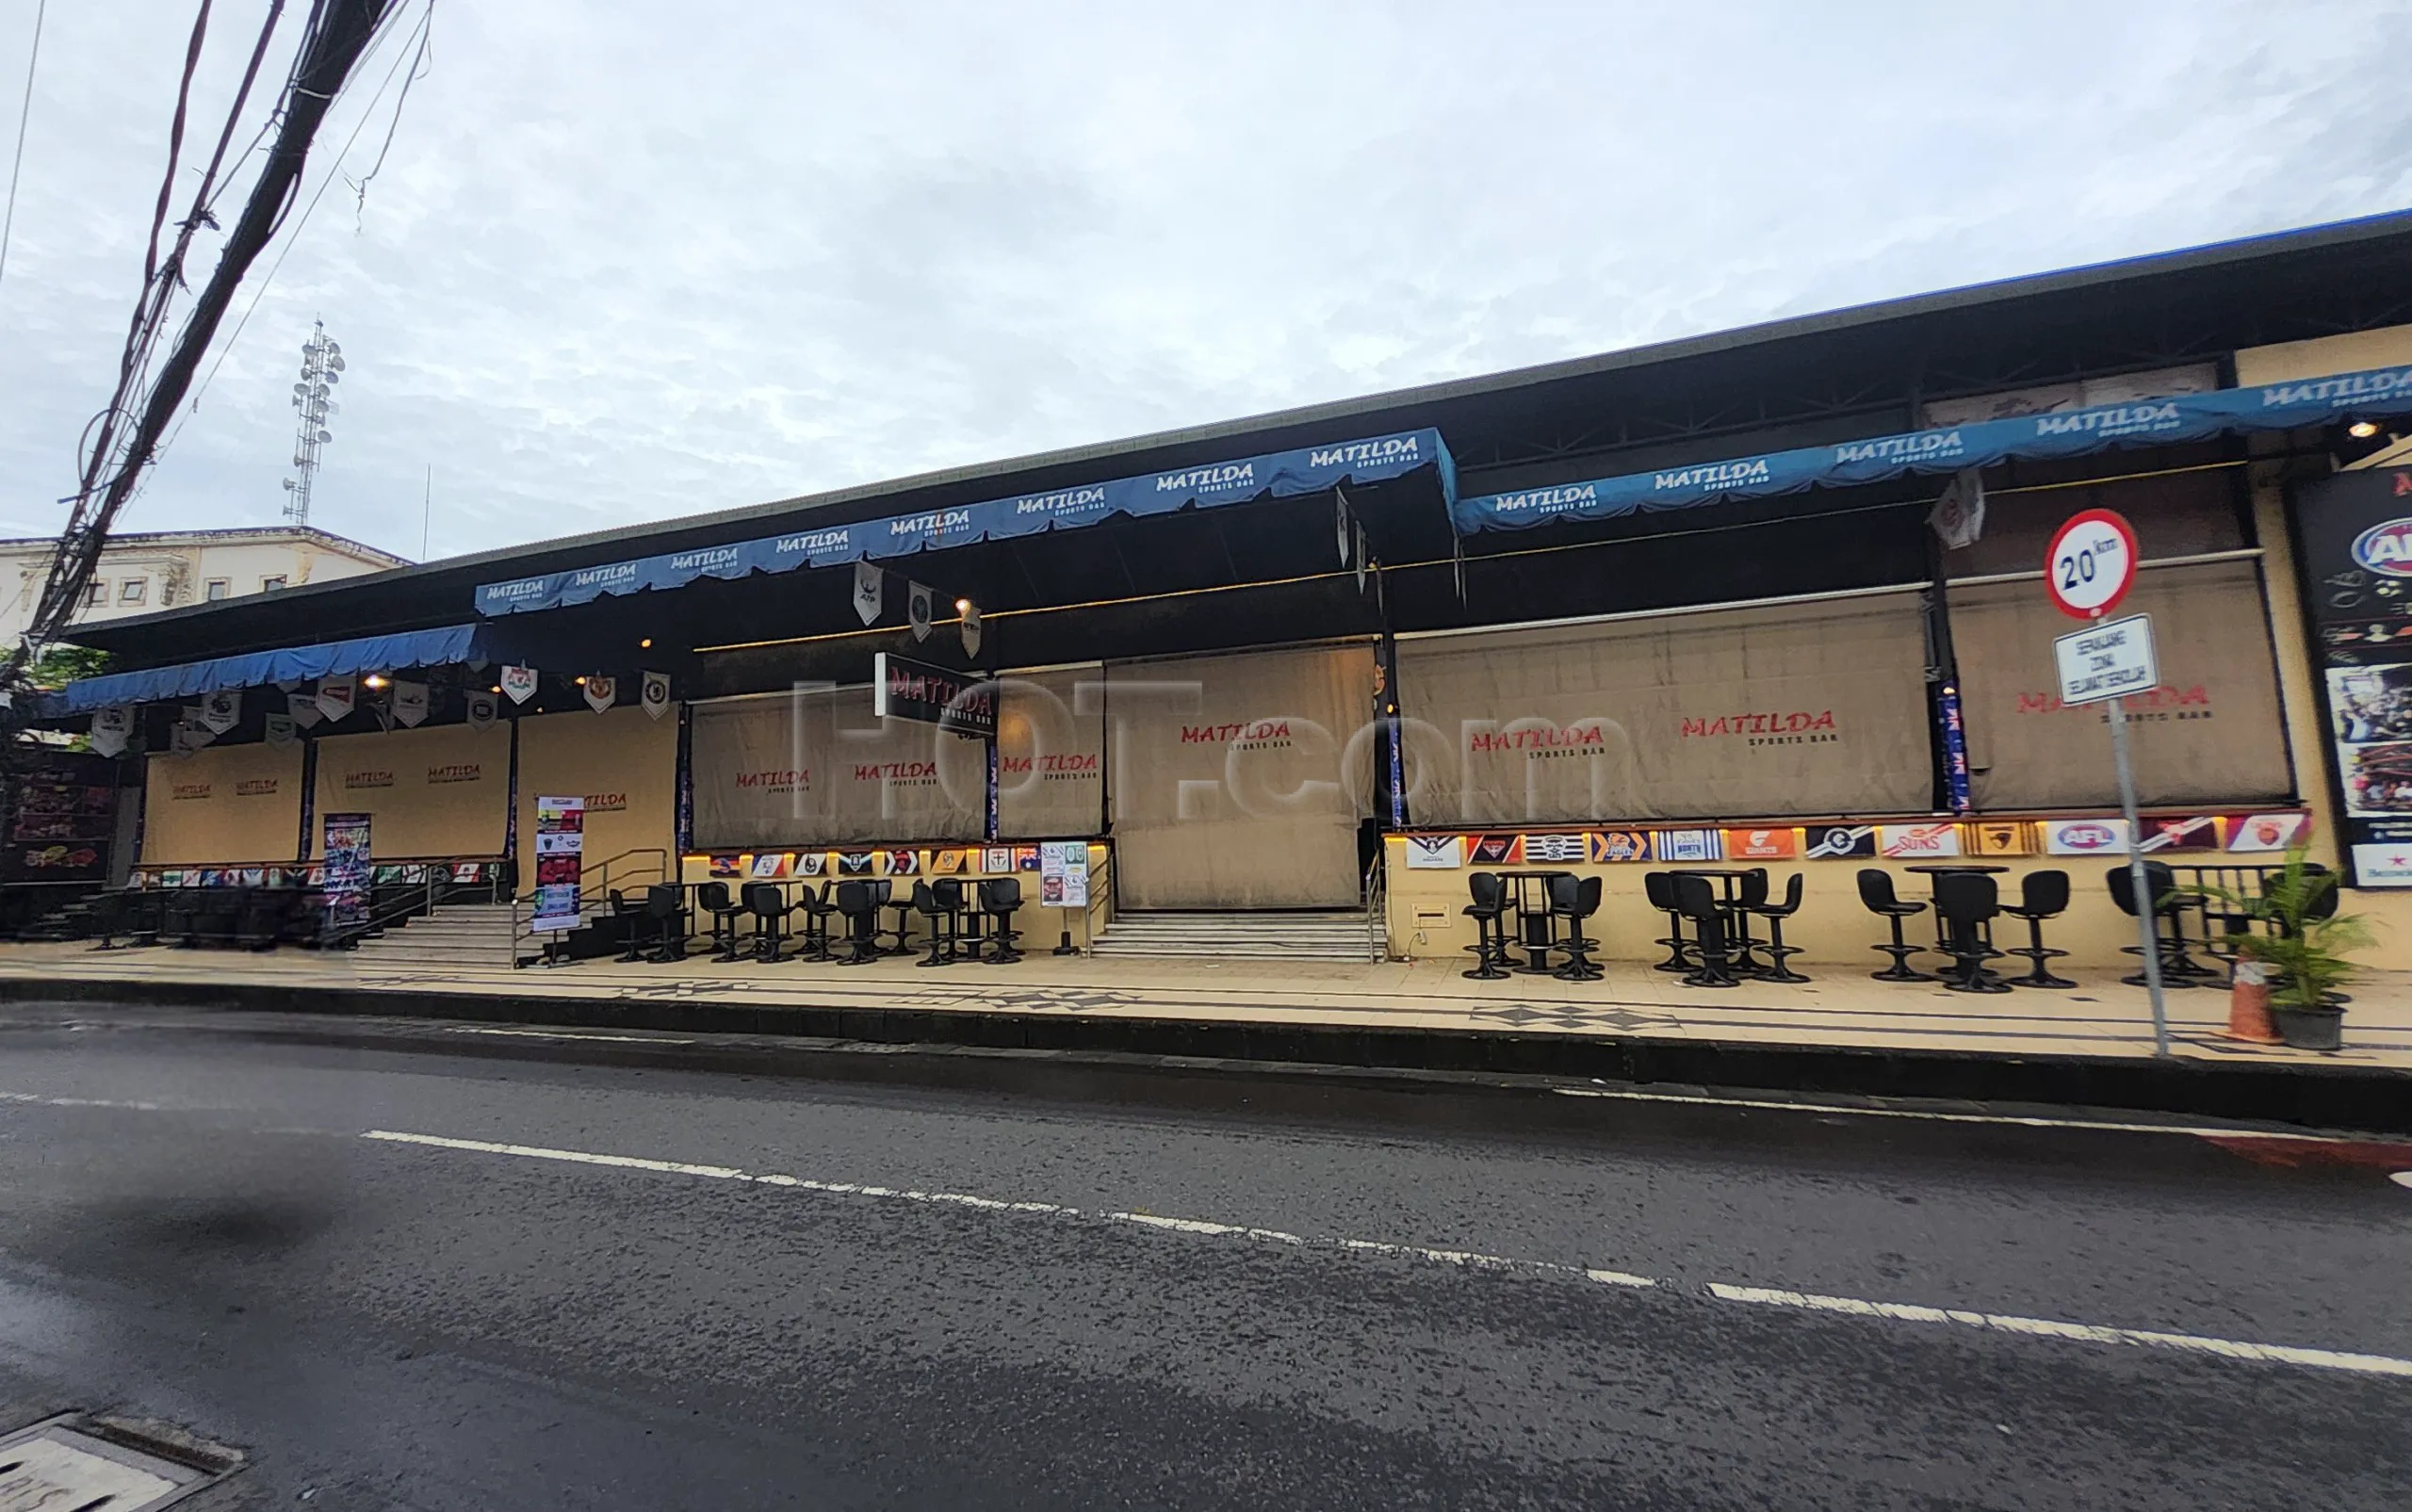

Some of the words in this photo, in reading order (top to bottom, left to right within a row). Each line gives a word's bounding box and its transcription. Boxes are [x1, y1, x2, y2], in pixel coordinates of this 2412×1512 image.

[2037, 401, 2180, 436] MATILDA
[1311, 436, 1418, 467] MATILDA
[1836, 431, 1964, 463] MATILDA
[1156, 463, 1254, 492] MATILDA
[1654, 459, 1769, 490] MATILDA
[1017, 487, 1105, 514] MATILDA
[1496, 484, 1597, 512] MATILDA
[889, 509, 970, 536] MATILDA
[776, 528, 849, 554] MATILDA
[671, 546, 738, 569] MATILDA
[2060, 549, 2095, 591] 20
[576, 563, 637, 587] MATILDA
[486, 579, 545, 600] MATILDA
[890, 665, 992, 715] MATILDA
[2016, 688, 2208, 713] MLDA
[1181, 721, 1291, 743] MATILDA
[1681, 710, 1836, 738] MATILDA
[1472, 725, 1604, 752] MATILDA
[1749, 736, 1803, 746] SPORTS
[429, 764, 481, 778] MATILDA
[855, 762, 937, 781] MATILDA
[1002, 754, 1097, 772] MATILDA
[736, 770, 809, 788] MATILDA
[584, 793, 627, 807] TILDA
[1899, 835, 1940, 851] SUNS
[2064, 829, 2109, 845] AFL
